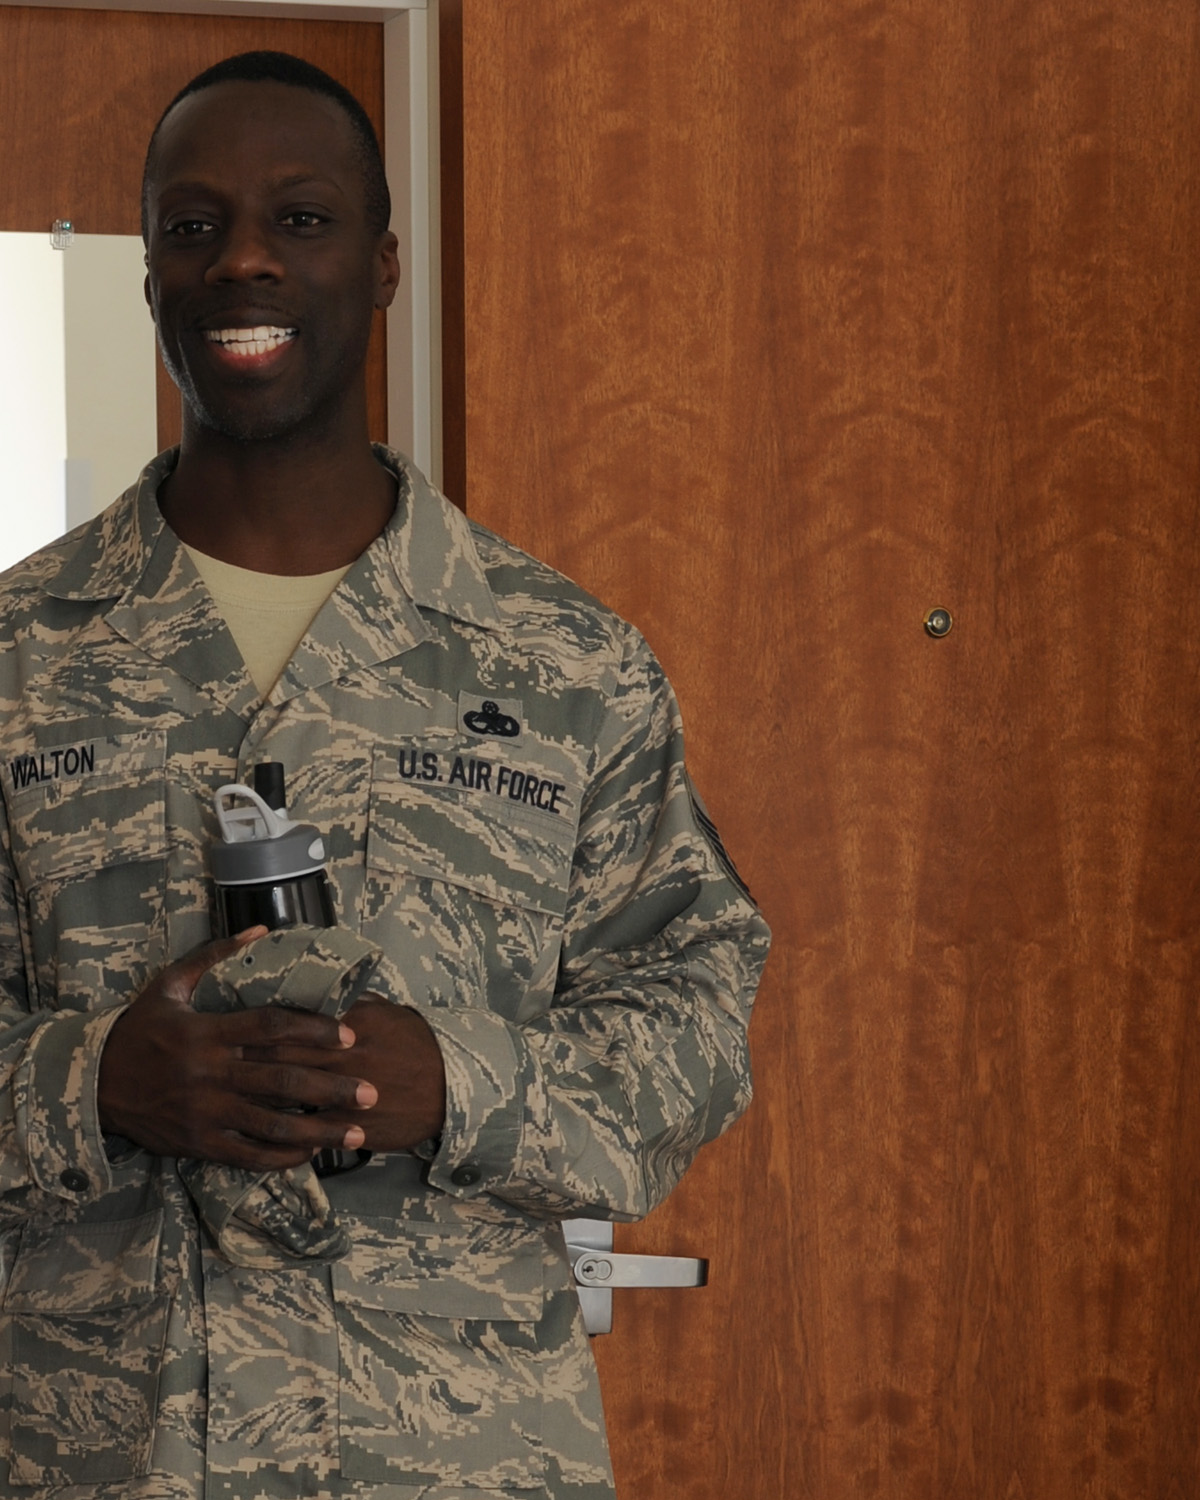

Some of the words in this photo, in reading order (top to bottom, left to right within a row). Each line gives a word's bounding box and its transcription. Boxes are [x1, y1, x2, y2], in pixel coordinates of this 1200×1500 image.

[10, 744, 94, 790] WALTON
[398, 749, 443, 782] U.S.
[449, 756, 492, 792] AIR
[496, 765, 566, 814] FORCE
